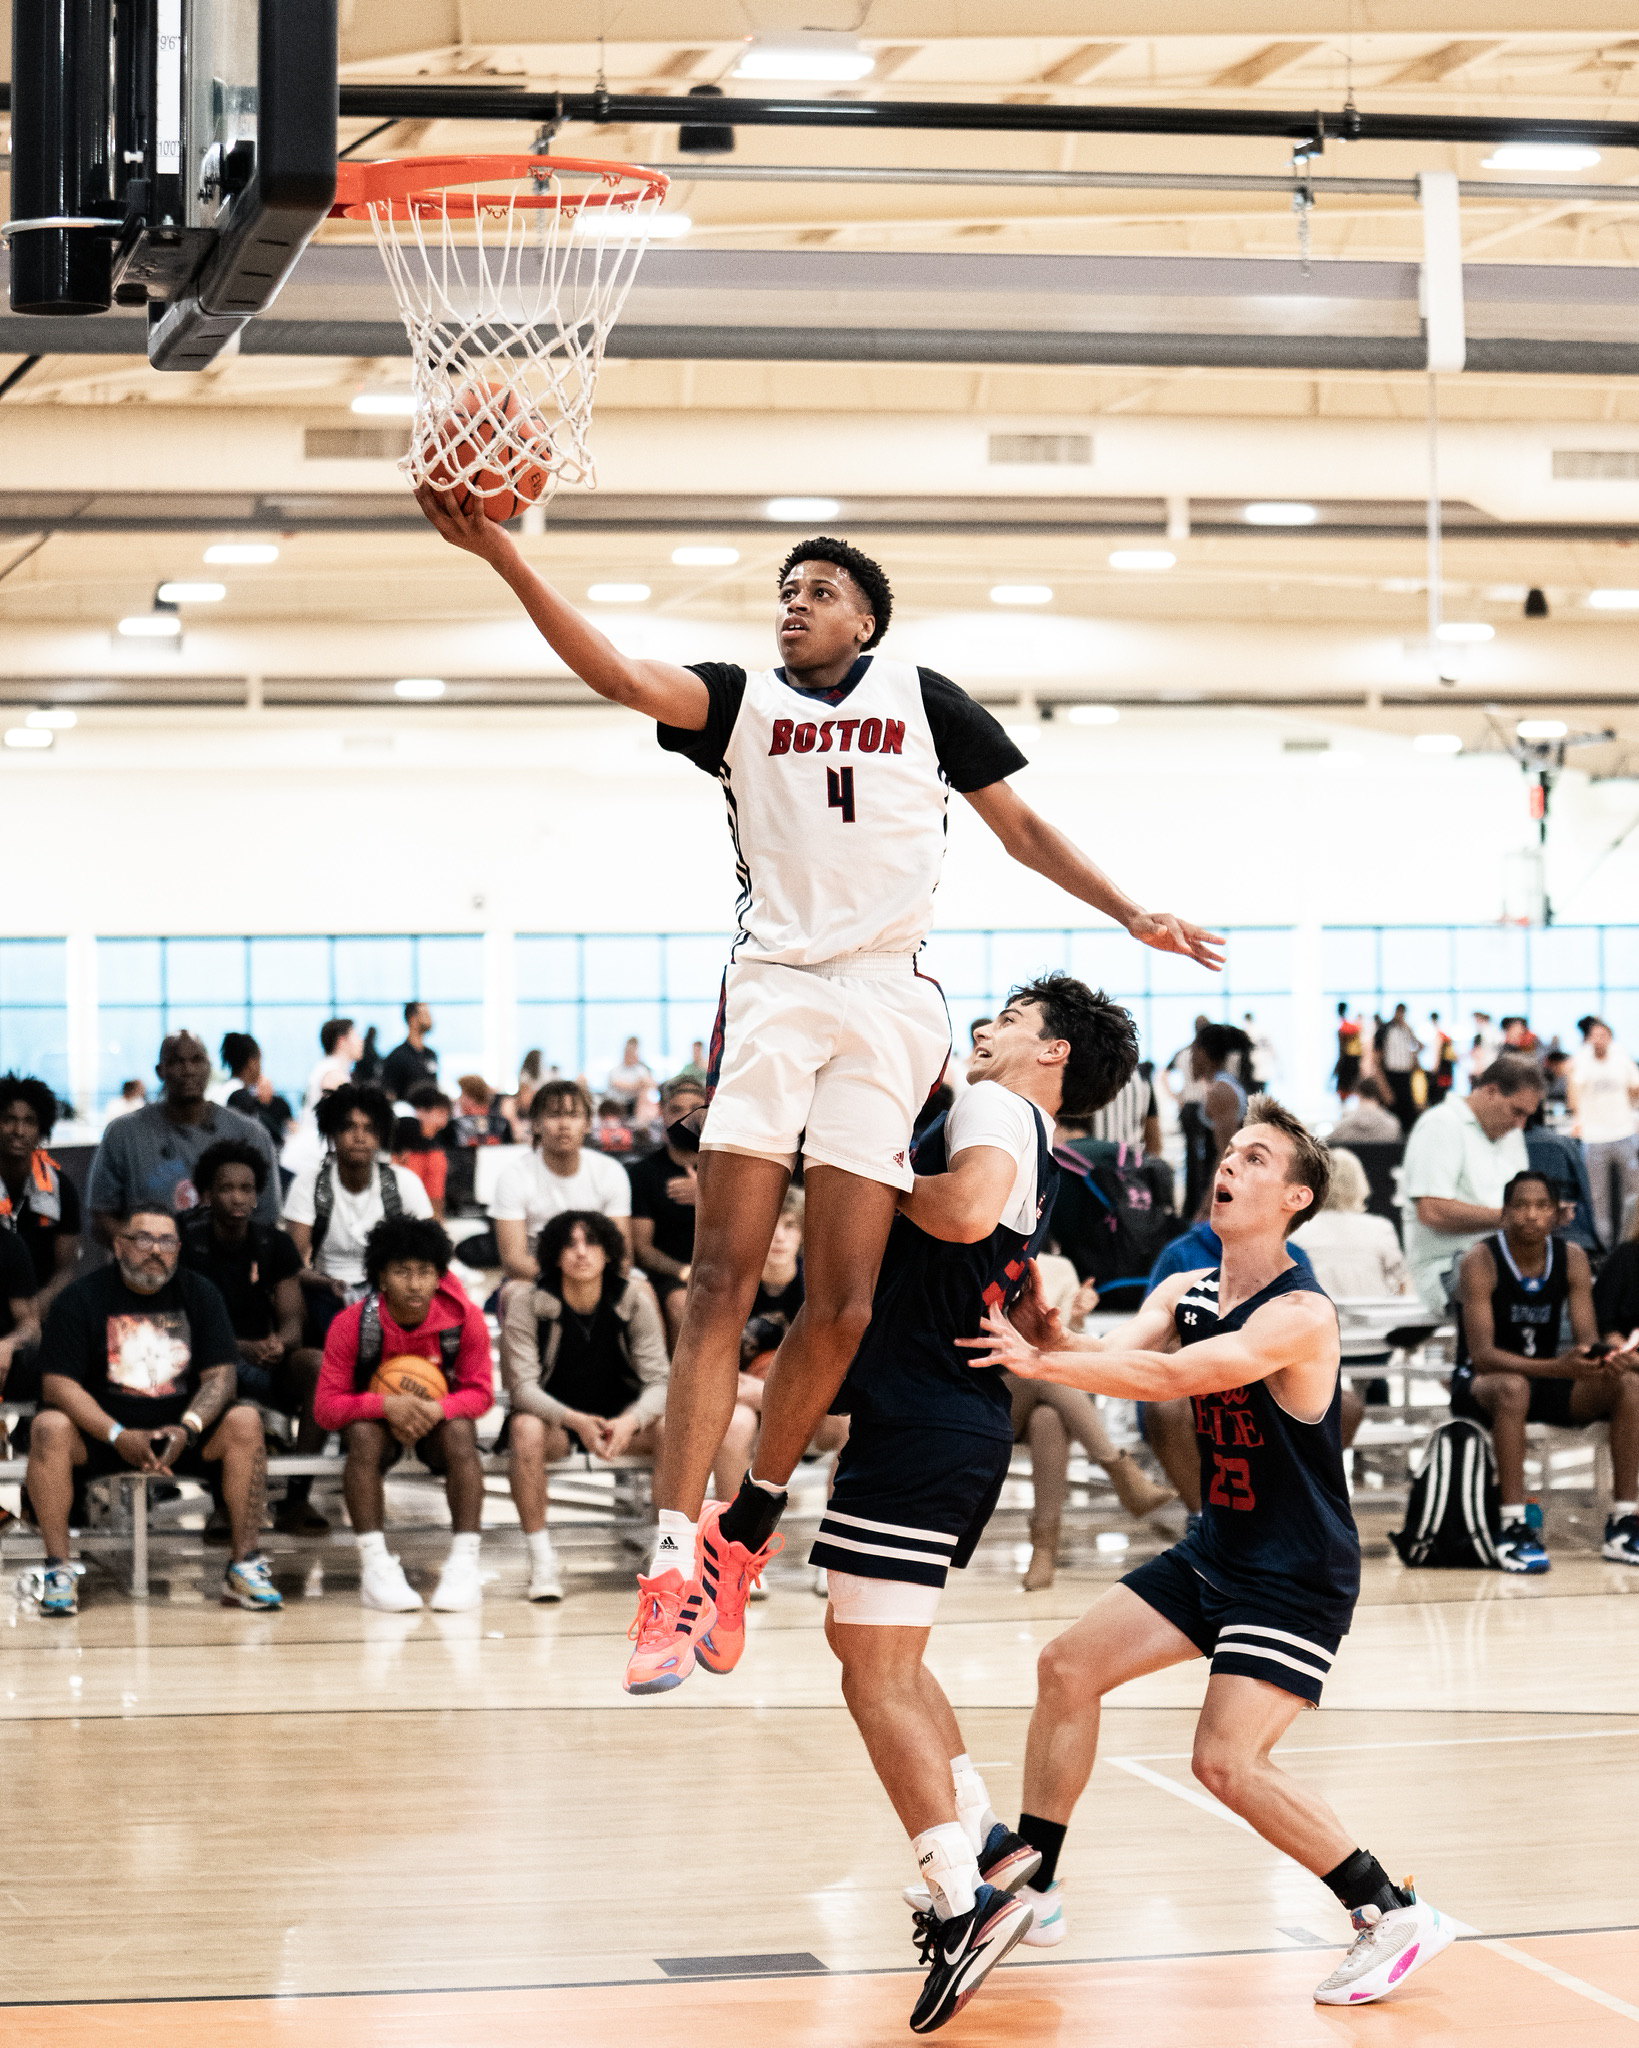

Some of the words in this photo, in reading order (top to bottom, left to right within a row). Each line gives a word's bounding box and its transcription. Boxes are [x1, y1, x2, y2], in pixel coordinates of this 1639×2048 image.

[768, 717, 906, 757] BOSTON
[826, 766, 856, 824] 4
[1209, 1452, 1256, 1512] 23
